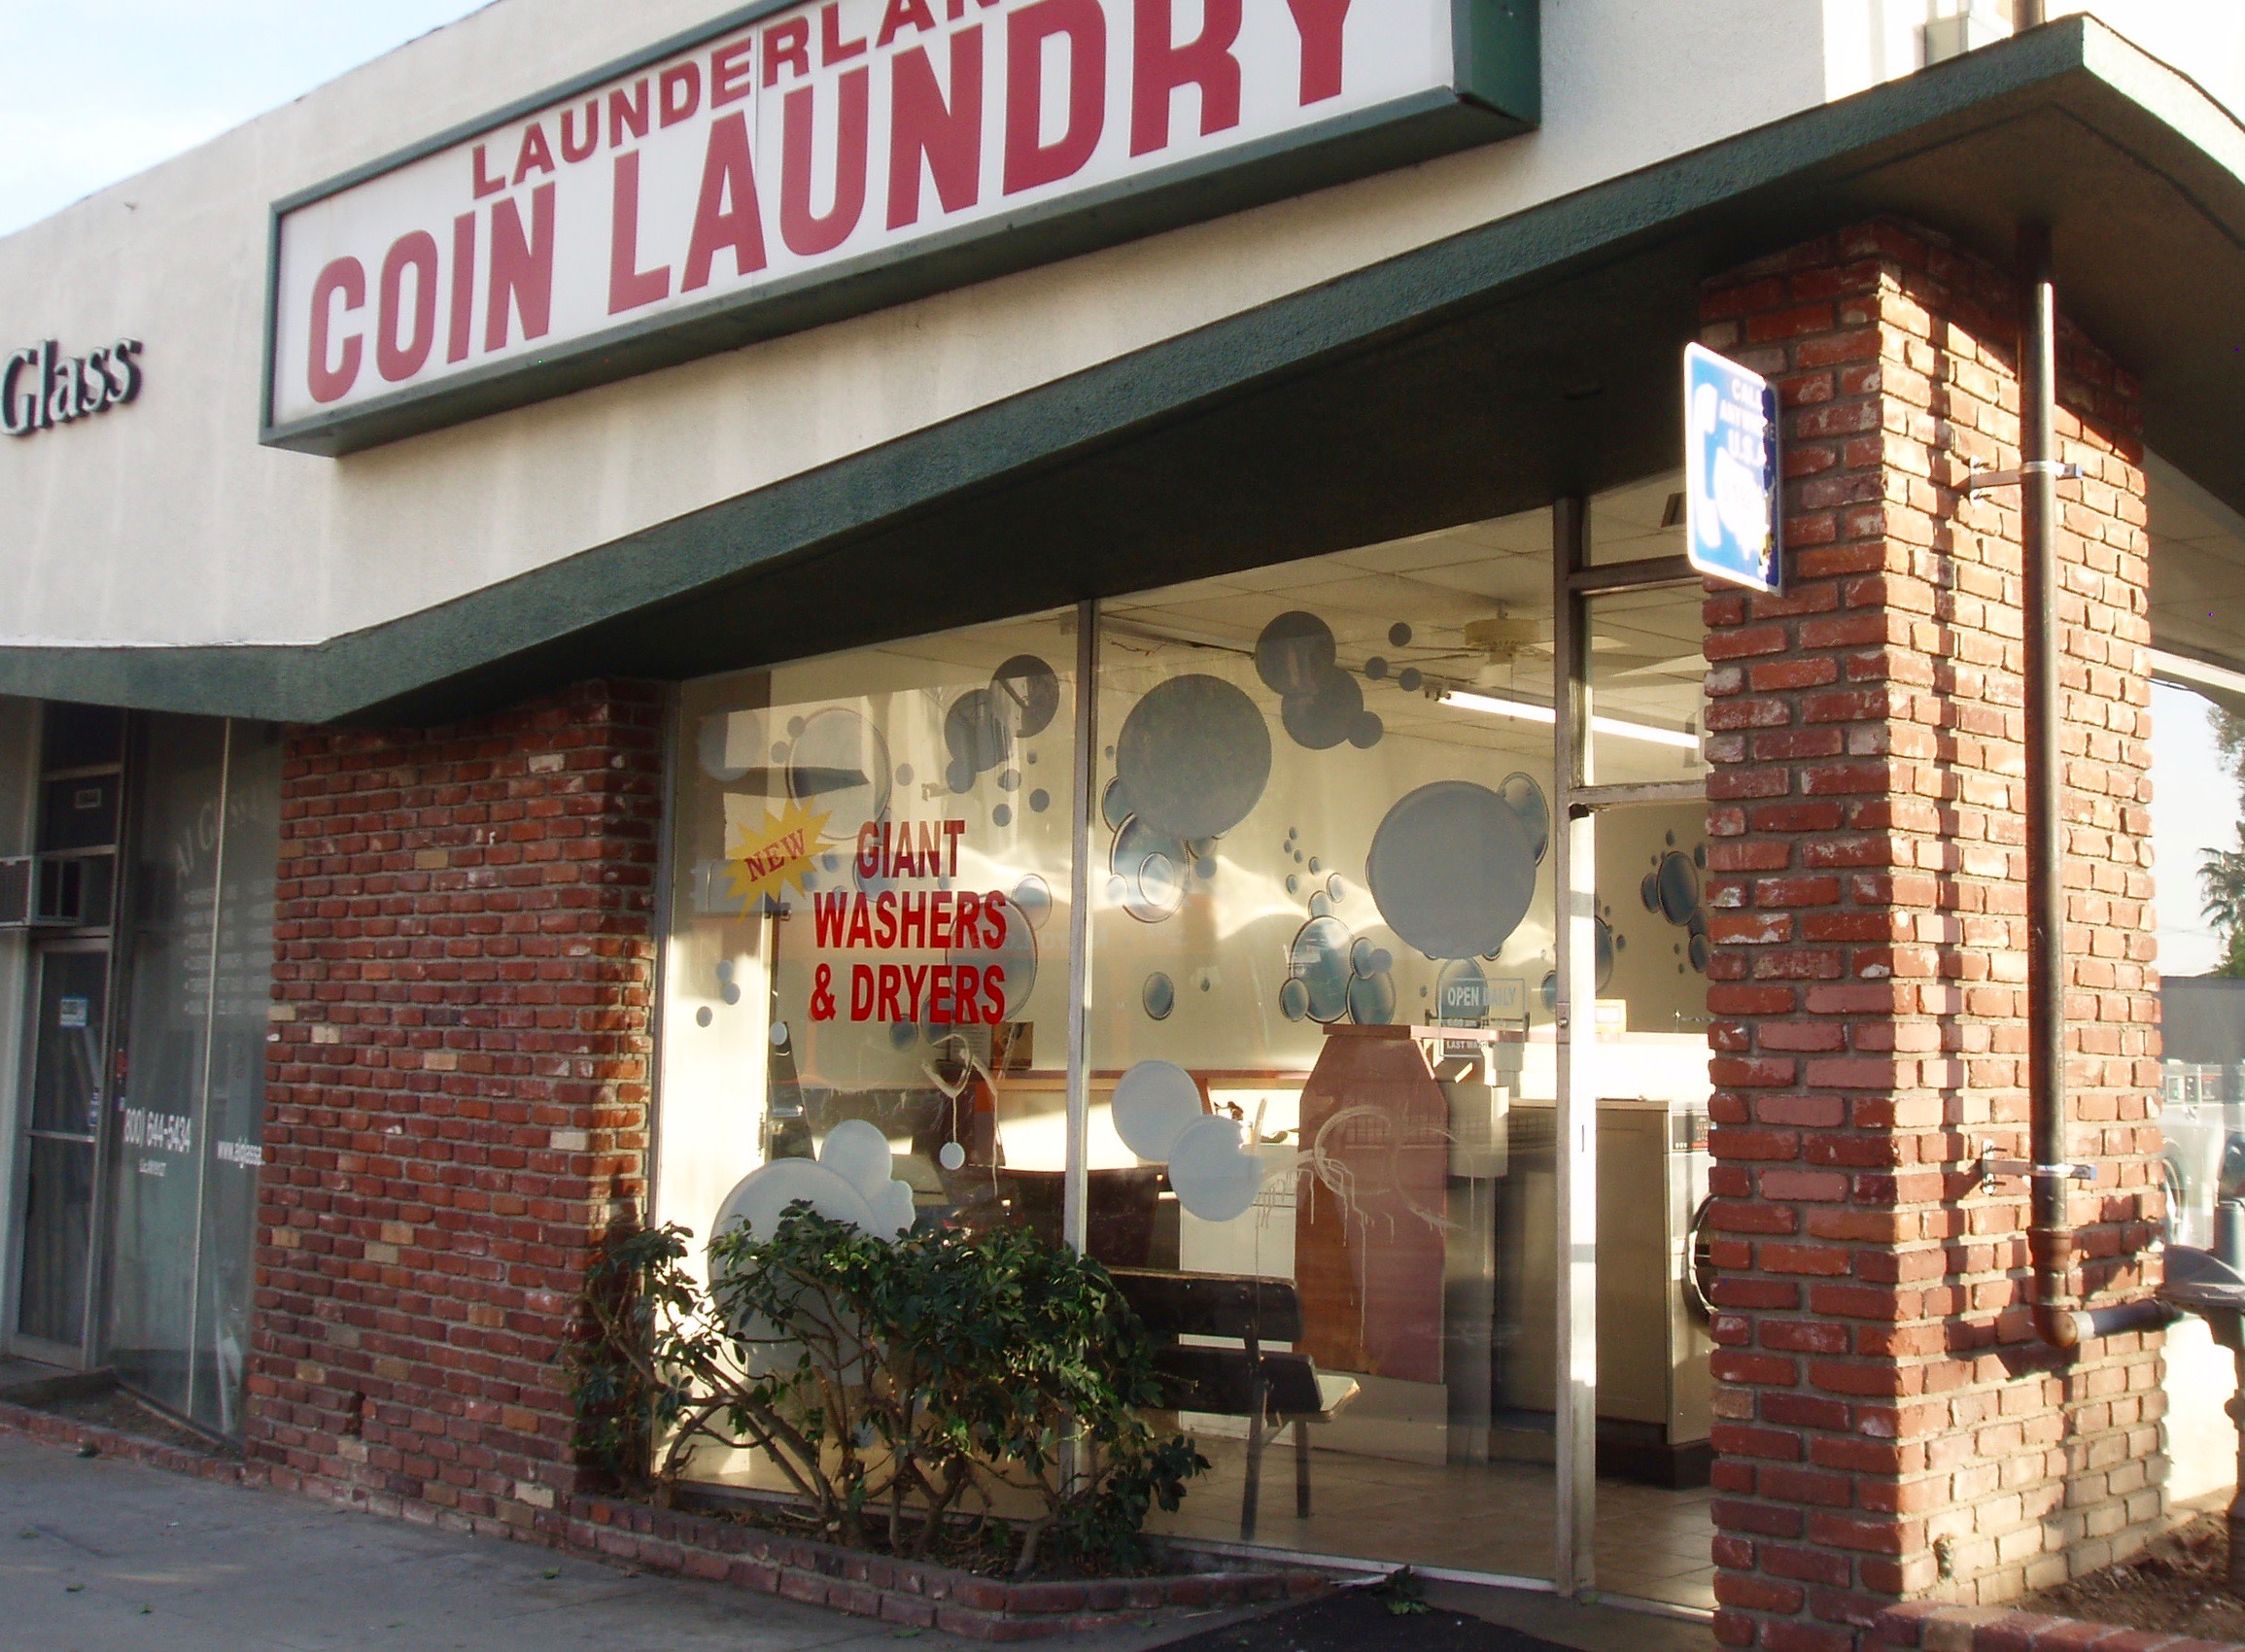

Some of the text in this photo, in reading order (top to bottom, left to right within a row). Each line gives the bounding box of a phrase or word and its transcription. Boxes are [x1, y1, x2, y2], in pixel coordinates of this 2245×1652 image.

[306, 0, 1352, 403] COIN LAUNDRY
[0, 337, 144, 437] Glass
[743, 827, 806, 882] NEW
[856, 819, 965, 879] GIANT
[813, 890, 1007, 950] WASHERS
[810, 963, 1006, 1026] & DRYERS
[1447, 986, 1479, 1007] OPEN
[1446, 1040, 1465, 1050] LAST
